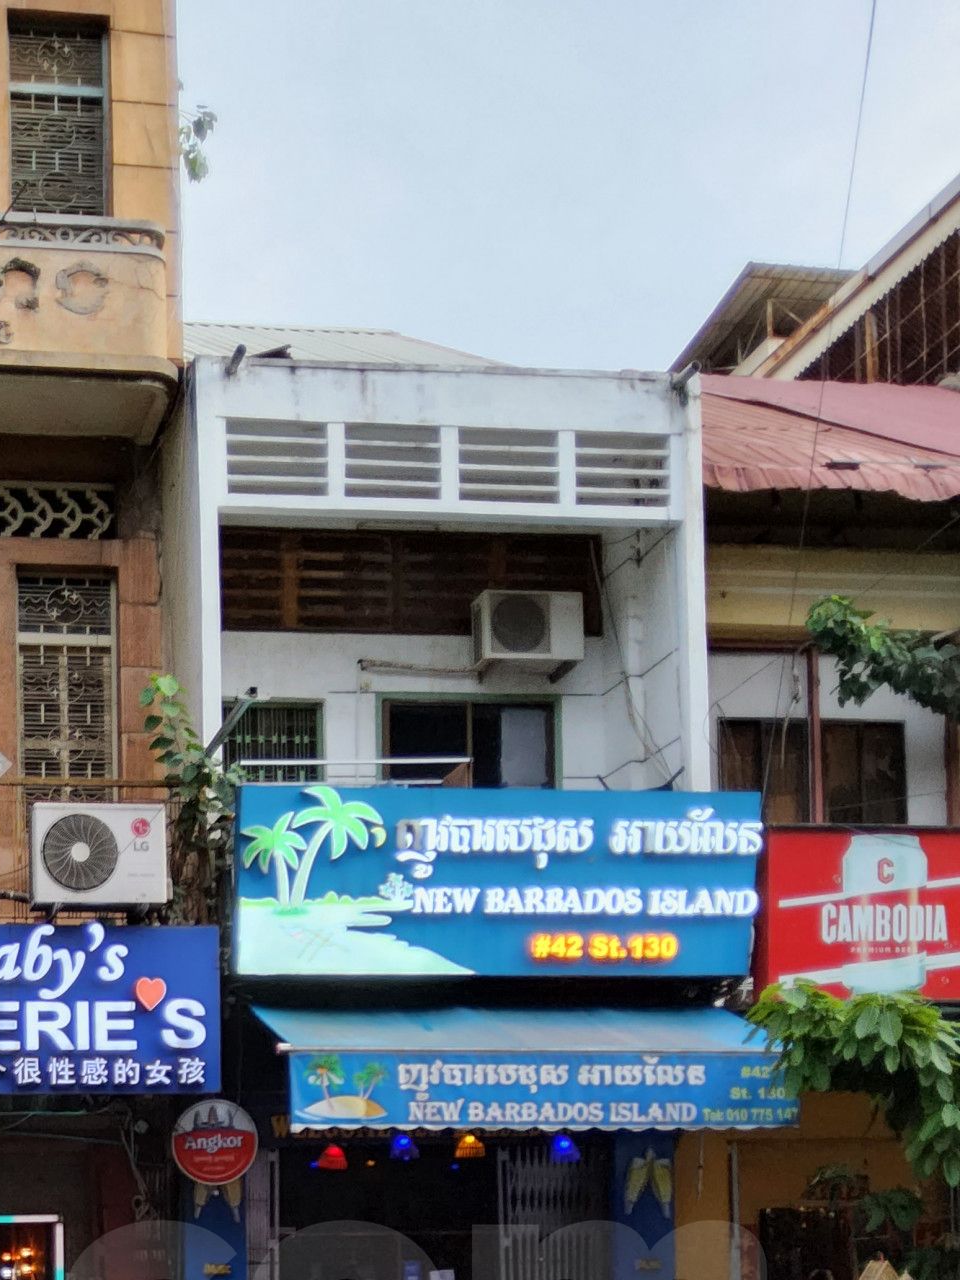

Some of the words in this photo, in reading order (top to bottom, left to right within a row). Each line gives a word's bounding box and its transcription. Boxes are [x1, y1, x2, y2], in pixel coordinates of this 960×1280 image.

[133, 841, 150, 852] LG
[412, 886, 482, 916] NEW
[484, 886, 643, 917] BARBADOS
[647, 888, 760, 917] ISLAND
[821, 902, 948, 945] CAMBODIA
[531, 932, 584, 960] #42
[408, 1099, 465, 1122] NEW
[468, 1102, 604, 1123] BARBADOS
[609, 1102, 698, 1122] ISLAND
[184, 1134, 244, 1154] Angkor
